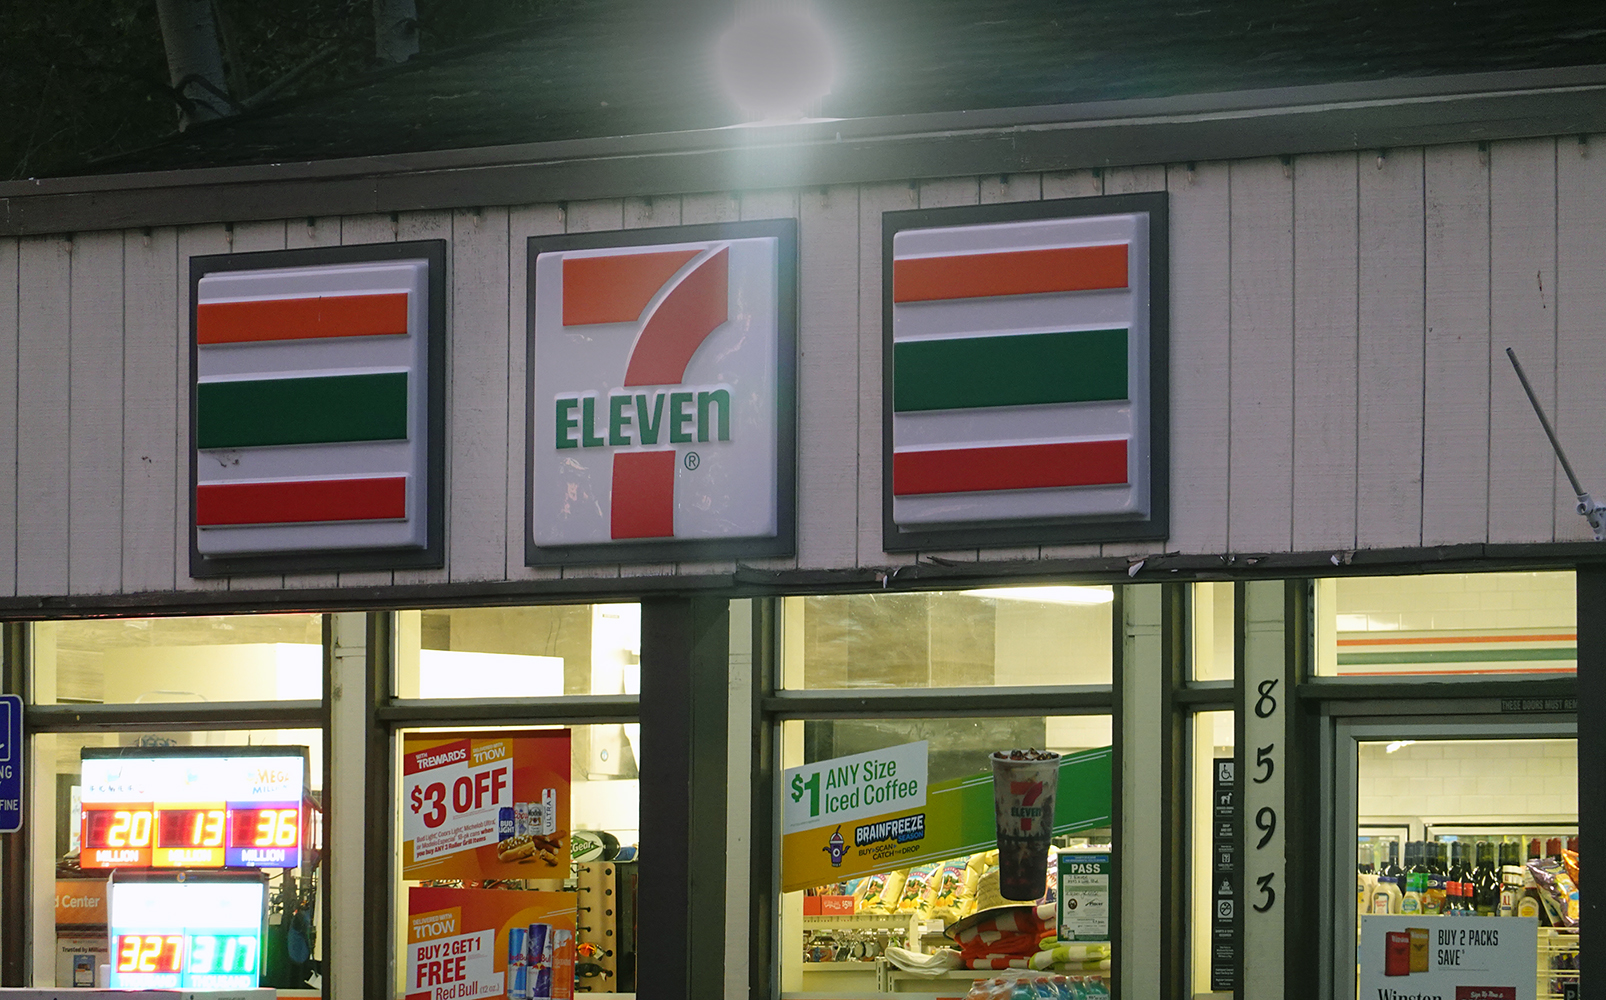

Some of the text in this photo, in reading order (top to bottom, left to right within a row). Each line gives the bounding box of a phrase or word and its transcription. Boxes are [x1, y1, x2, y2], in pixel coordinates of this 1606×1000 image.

[562, 246, 730, 540] 7
[555, 388, 731, 450] ELEVEn
[1502, 700, 1521, 710] THESE
[1522, 700, 1544, 710] DOORS
[1544, 700, 1562, 710] MUST
[416, 748, 466, 770] 7REWARDS
[826, 760, 897, 790] ANY Size
[0, 800, 18, 810] FINE
[410, 766, 507, 828] $3 OFF
[791, 772, 820, 817] $1
[826, 779, 918, 814] Iced Coffee
[1252, 678, 1279, 913] 8593
[108, 811, 152, 846] 20
[194, 811, 224, 846] 13
[255, 810, 298, 846] 36
[856, 815, 924, 845] BRAINFREEZE
[898, 831, 924, 842] SEASON
[96, 850, 139, 862] MILLION
[168, 850, 212, 862] MILLION
[242, 850, 285, 862] MILLION
[425, 847, 433, 855] buy
[859, 844, 893, 856] BUY SCAN
[873, 851, 894, 860] CATCH
[902, 845, 920, 854] DROP
[1071, 864, 1100, 873] PASS
[62, 895, 100, 908] Center
[417, 944, 441, 961] BUY
[443, 943, 450, 957] 2
[452, 938, 474, 955] GET
[475, 936, 481, 950] 1
[1438, 929, 1498, 946] BUY 2 PACKS
[118, 935, 182, 972] 327
[192, 935, 257, 973] 317
[1438, 950, 1460, 966] SAVE
[416, 956, 466, 988] FREE
[436, 984, 456, 1000] Red
[458, 981, 478, 998] Bull
